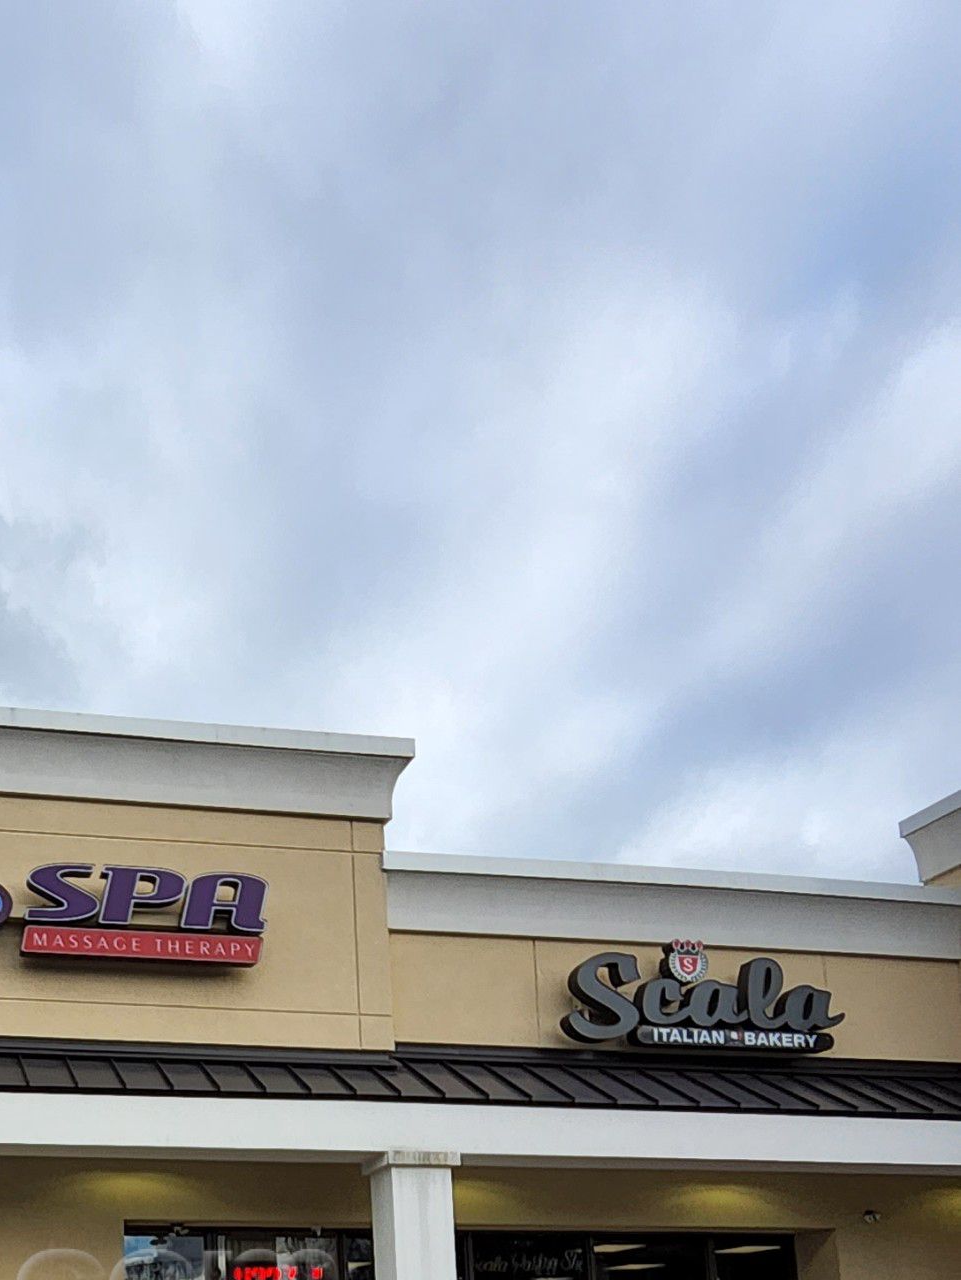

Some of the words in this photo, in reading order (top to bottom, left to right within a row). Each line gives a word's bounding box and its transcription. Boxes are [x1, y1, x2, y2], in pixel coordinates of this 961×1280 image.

[23, 863, 270, 932] SPA
[32, 932, 142, 953] MASSAGE
[154, 937, 256, 959] THERAPY
[566, 951, 845, 1040] Scala
[652, 1027, 725, 1045] ITALIAN
[744, 1032, 818, 1048] BAKERY
